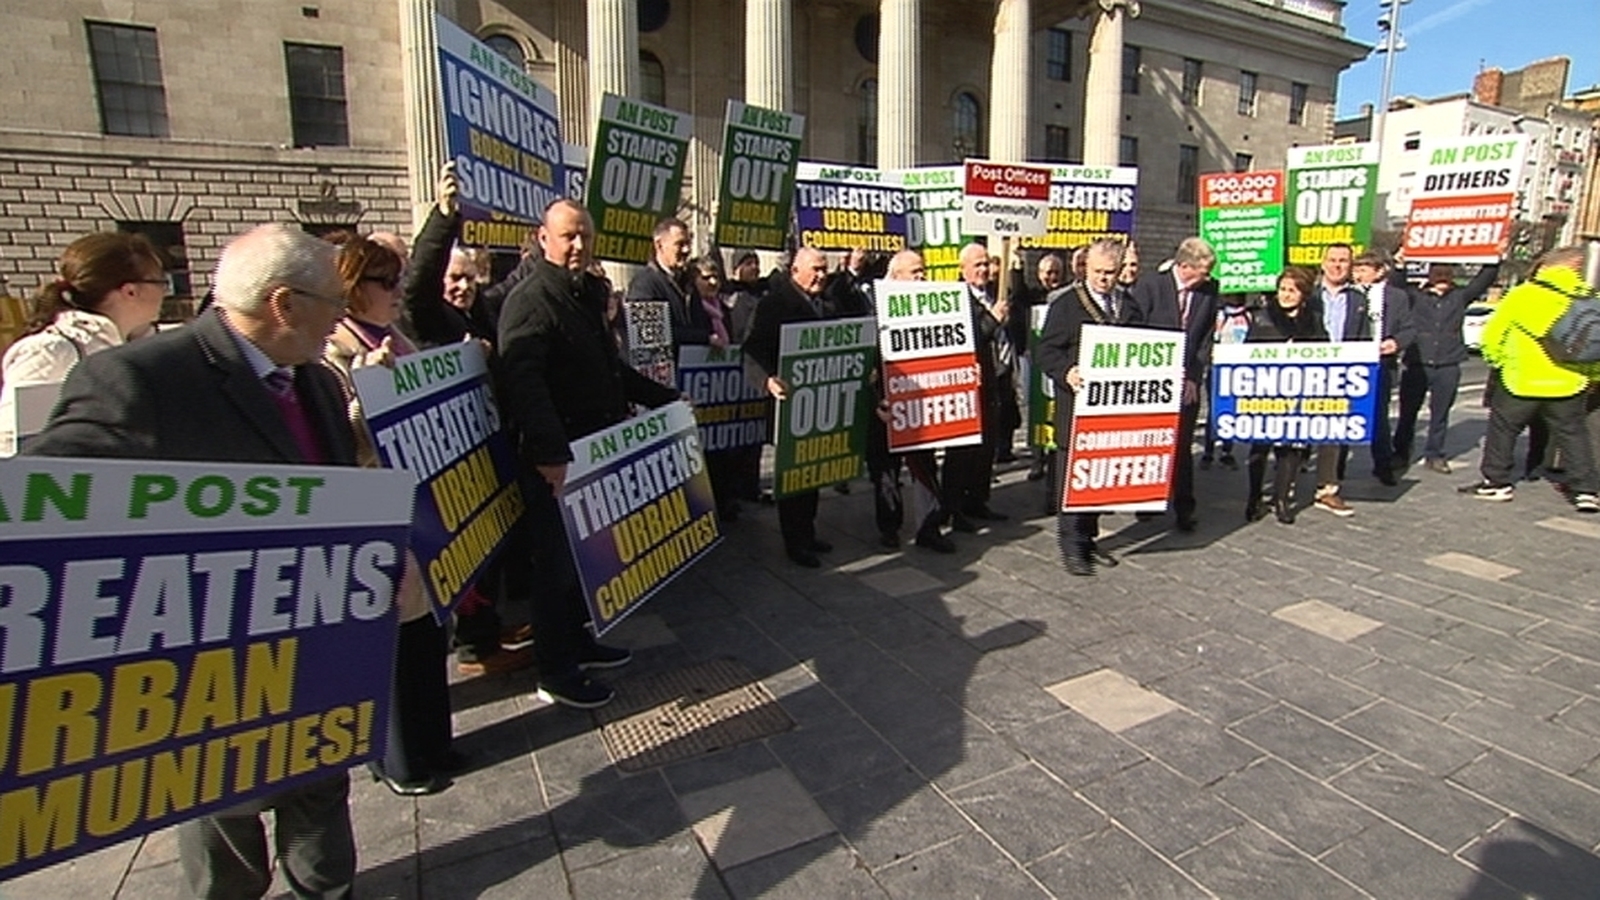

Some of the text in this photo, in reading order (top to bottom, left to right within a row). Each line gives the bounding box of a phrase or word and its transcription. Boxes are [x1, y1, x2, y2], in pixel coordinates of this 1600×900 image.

[470, 42, 537, 98] AN POST
[446, 59, 560, 164] IGNORES
[616, 101, 679, 134] AN POST
[761, 110, 792, 132] POST
[607, 129, 678, 166] STAMPS
[734, 132, 792, 162] STAMPS
[1303, 147, 1364, 164] AN POST
[1429, 141, 1518, 165] AN POST
[602, 157, 673, 211] OUT
[729, 156, 788, 202] OUT
[841, 168, 882, 182] POST
[923, 170, 955, 184] POST
[972, 164, 1046, 184] Post Offices
[1072, 168, 1112, 179] POST
[1296, 167, 1369, 190] STAMPS
[1424, 168, 1511, 192] DITHERS
[796, 184, 905, 214] THREATENS
[994, 182, 1027, 197] Close
[1049, 185, 1133, 211] REATENS
[1208, 189, 1274, 205] PEOPLE
[823, 210, 884, 232] URBAN
[974, 200, 1039, 219] Community
[1295, 188, 1365, 225] OUT
[906, 211, 962, 246] OUT
[994, 218, 1019, 232] Dies
[1407, 222, 1504, 249] SUFFER!
[802, 230, 905, 251] COMMUNITIES!
[888, 291, 961, 317] AN POST
[799, 324, 863, 349] AN POST
[890, 323, 966, 352] DITHERS
[1091, 342, 1176, 368] AN POST
[1250, 346, 1342, 359] AN POST
[393, 350, 463, 395] AN POST
[792, 352, 865, 386] STAMPS
[1219, 365, 1370, 397] IGNORES
[1086, 379, 1174, 406] DITHERS
[790, 380, 861, 437] OUT
[892, 390, 977, 431] SUFFER!
[376, 383, 500, 481] THREATENS
[588, 414, 668, 464] AN POST
[1076, 427, 1175, 451] COMMUNITIES
[1217, 414, 1367, 440] SOLUTIONS
[795, 431, 850, 464] RURAL
[782, 455, 860, 493] IRELAND!
[1071, 453, 1171, 491] SUFFER!
[127, 474, 326, 519] POST
[431, 445, 499, 532] URBAN
[564, 435, 703, 540] THREATENS
[612, 487, 691, 563] URBAN
[596, 511, 718, 621] COMMUNITIES!
[0, 541, 398, 674] REATENS
[0, 700, 375, 869] MUNITIES!
